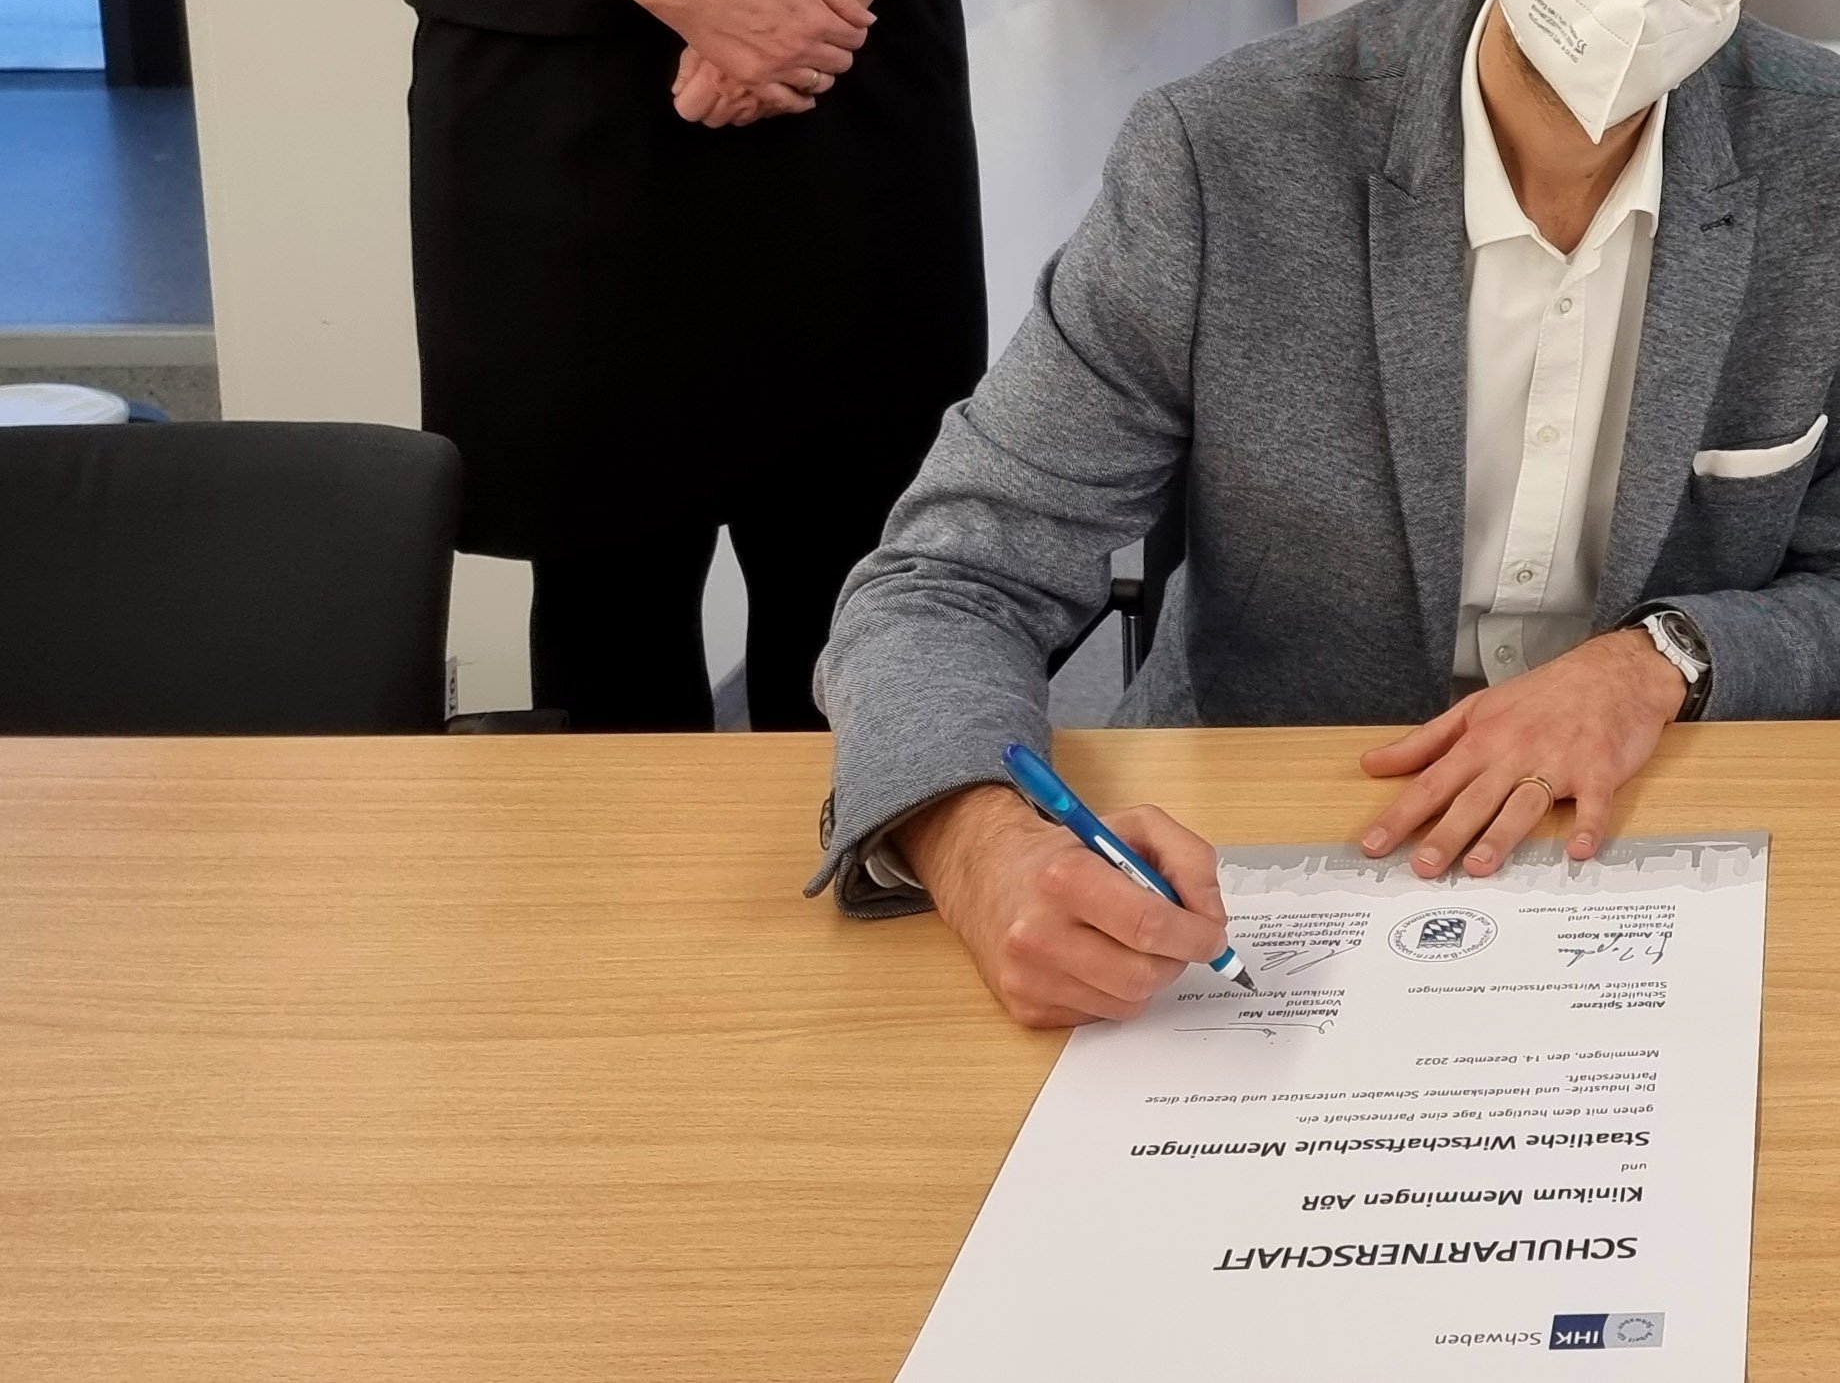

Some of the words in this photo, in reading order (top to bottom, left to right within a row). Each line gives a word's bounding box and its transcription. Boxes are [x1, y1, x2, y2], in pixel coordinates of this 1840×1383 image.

[1518, 905, 1578, 915] Schwaben
[1582, 904, 1676, 913] Handelskammer
[1276, 911, 1371, 921] Handelskammer
[1567, 915, 1590, 923] und
[1593, 913, 1652, 922] Industrie-
[1656, 913, 1676, 921] der
[1258, 922, 1283, 930] und
[1286, 921, 1346, 929] Industrie-
[1619, 921, 1674, 931] Präsident
[1233, 929, 1365, 939] Hauptgeschäftsführer
[1557, 931, 1600, 941] Kopton
[1603, 931, 1652, 941] Andreas
[1656, 931, 1673, 939] Dr.
[1251, 939, 1306, 948] Lucassen
[1308, 939, 1341, 947] Marc
[1346, 938, 1362, 947] Dr.
[1407, 985, 1486, 995] Memmingen
[1490, 982, 1601, 993] Wirtschaftsschule
[1604, 981, 1668, 991] Staatliche
[1176, 993, 1204, 1001] AöR
[1208, 989, 1287, 999] Memmingen
[1290, 989, 1346, 997] Klinikum
[1599, 991, 1666, 999] Schulleiter
[1285, 999, 1342, 1007] Vorstand
[1570, 1000, 1623, 1011] Spitzner
[1626, 1000, 1666, 1010] Albert
[1522, 1054, 1541, 1063] 14.
[1546, 1053, 1570, 1062] den
[1574, 1049, 1660, 1060] Memmingen,
[1415, 1057, 1449, 1066] 2022
[1452, 1055, 1518, 1065] Dezember
[1564, 1071, 1657, 1083] Partnerschaft.
[1423, 1087, 1530, 1099] Handelskammer
[1535, 1086, 1560, 1095] und
[1564, 1084, 1630, 1095] Industrie-
[1634, 1083, 1656, 1093] Die
[1144, 1095, 1180, 1105] diese
[1183, 1093, 1237, 1105] bezeugt
[1241, 1094, 1267, 1104] und
[1271, 1092, 1346, 1103] unterstützt
[1351, 1089, 1419, 1101] Schwaben
[1452, 1110, 1482, 1120] Tage
[1488, 1108, 1548, 1119] heutigen
[1552, 1108, 1580, 1118] dem
[1586, 1107, 1608, 1117] mit
[1613, 1104, 1654, 1116] gehen
[1295, 1115, 1319, 1125] ein.
[1323, 1112, 1415, 1124] Partnerschaft
[1420, 1112, 1448, 1121] eine
[1525, 1131, 1650, 1148] Staatliche
[1130, 1141, 1286, 1158] Memmingen
[1295, 1135, 1516, 1155] Wirtschaftsschule
[1620, 1163, 1648, 1173] und
[1364, 1189, 1523, 1209] Memmingen
[1533, 1186, 1644, 1204] Klinikum
[1302, 1195, 1356, 1211] AöR
[1213, 1237, 1638, 1271] SCHULPARTNERSCHAFT
[1435, 1331, 1542, 1347] Schwaben
[1554, 1330, 1599, 1345] IHK
